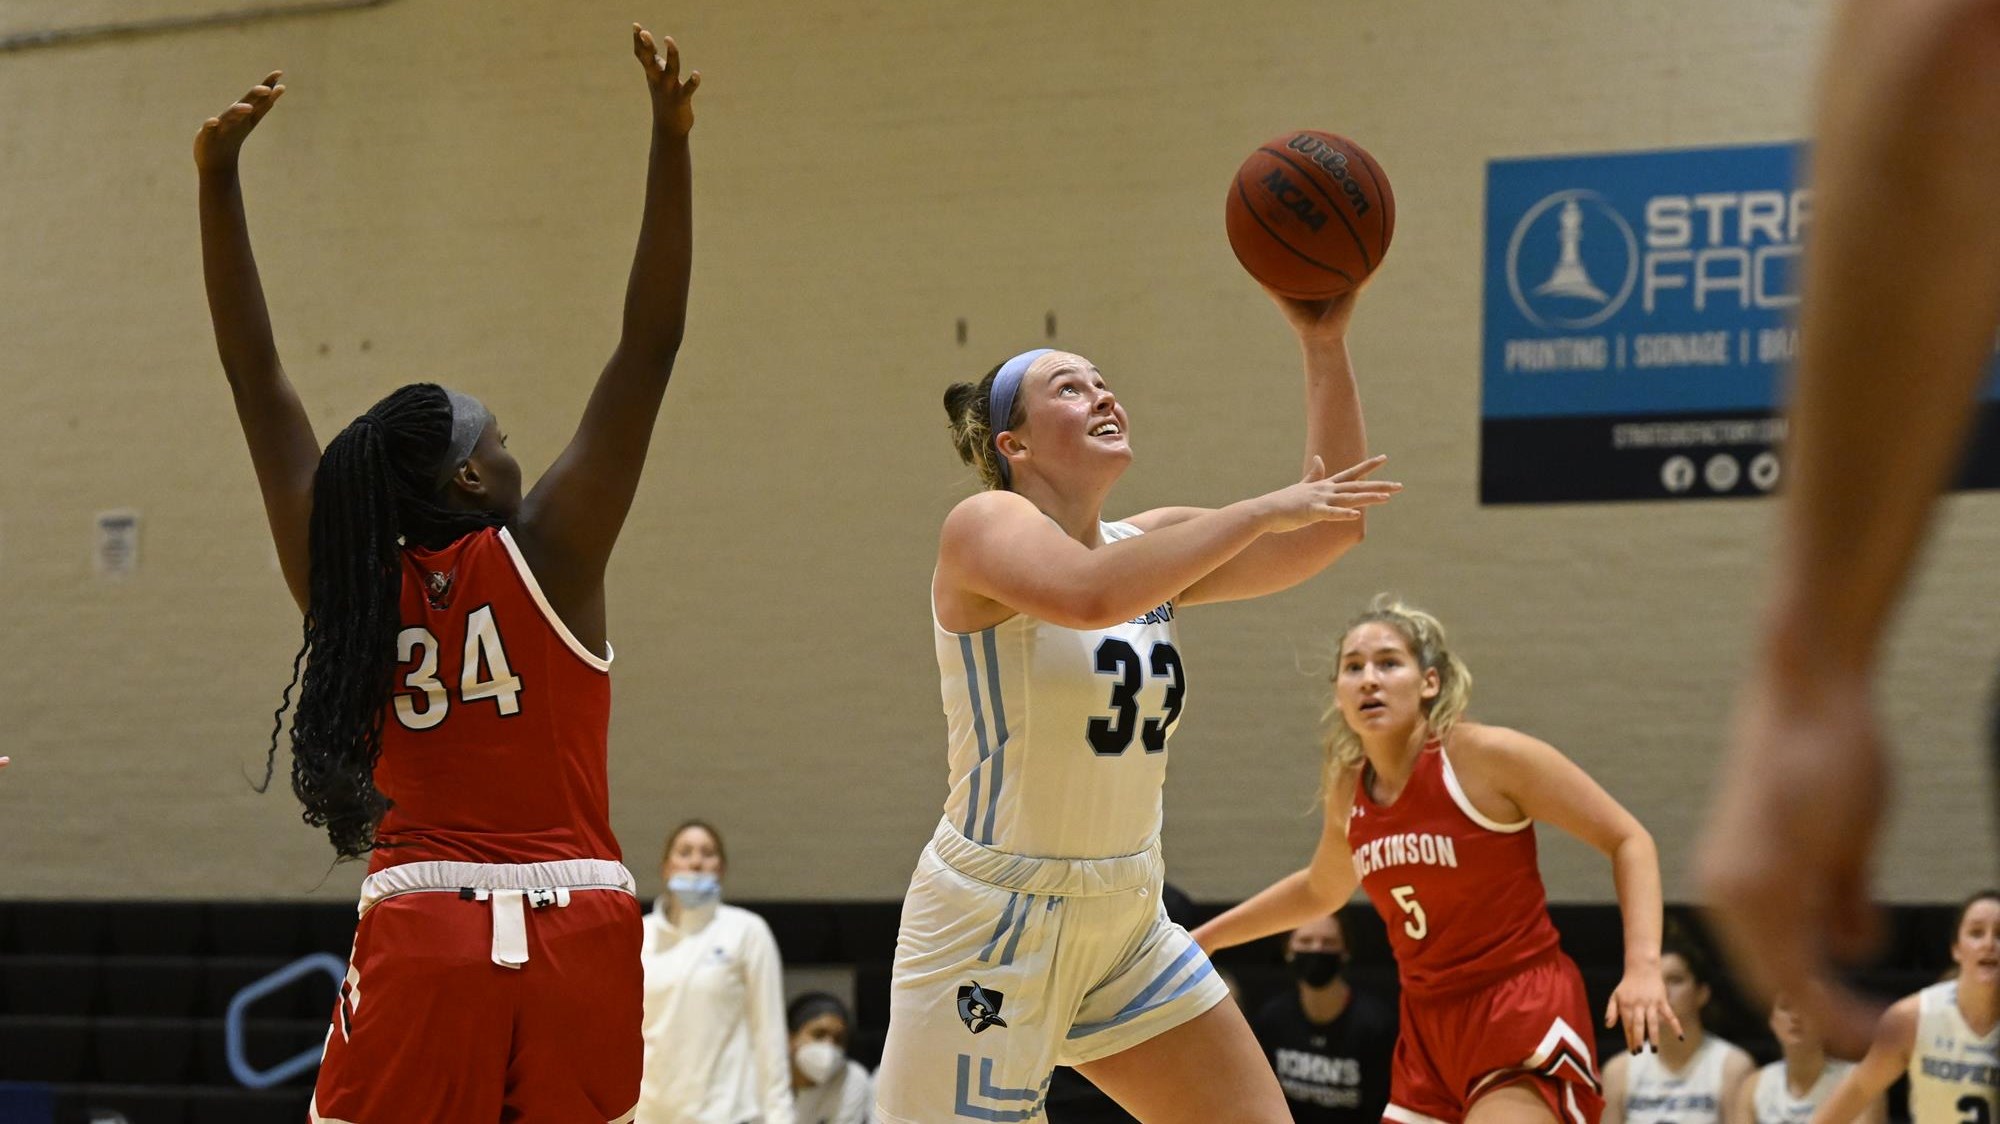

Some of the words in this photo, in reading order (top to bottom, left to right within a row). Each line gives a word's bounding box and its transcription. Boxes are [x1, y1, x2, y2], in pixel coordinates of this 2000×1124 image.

[1287, 134, 1371, 219] Wilson
[1505, 336, 1608, 373] PRINTING
[1634, 330, 1729, 368] SIGNAGE
[393, 602, 523, 732] 34
[1085, 635, 1186, 757] 33
[1390, 884, 1427, 941] 5
